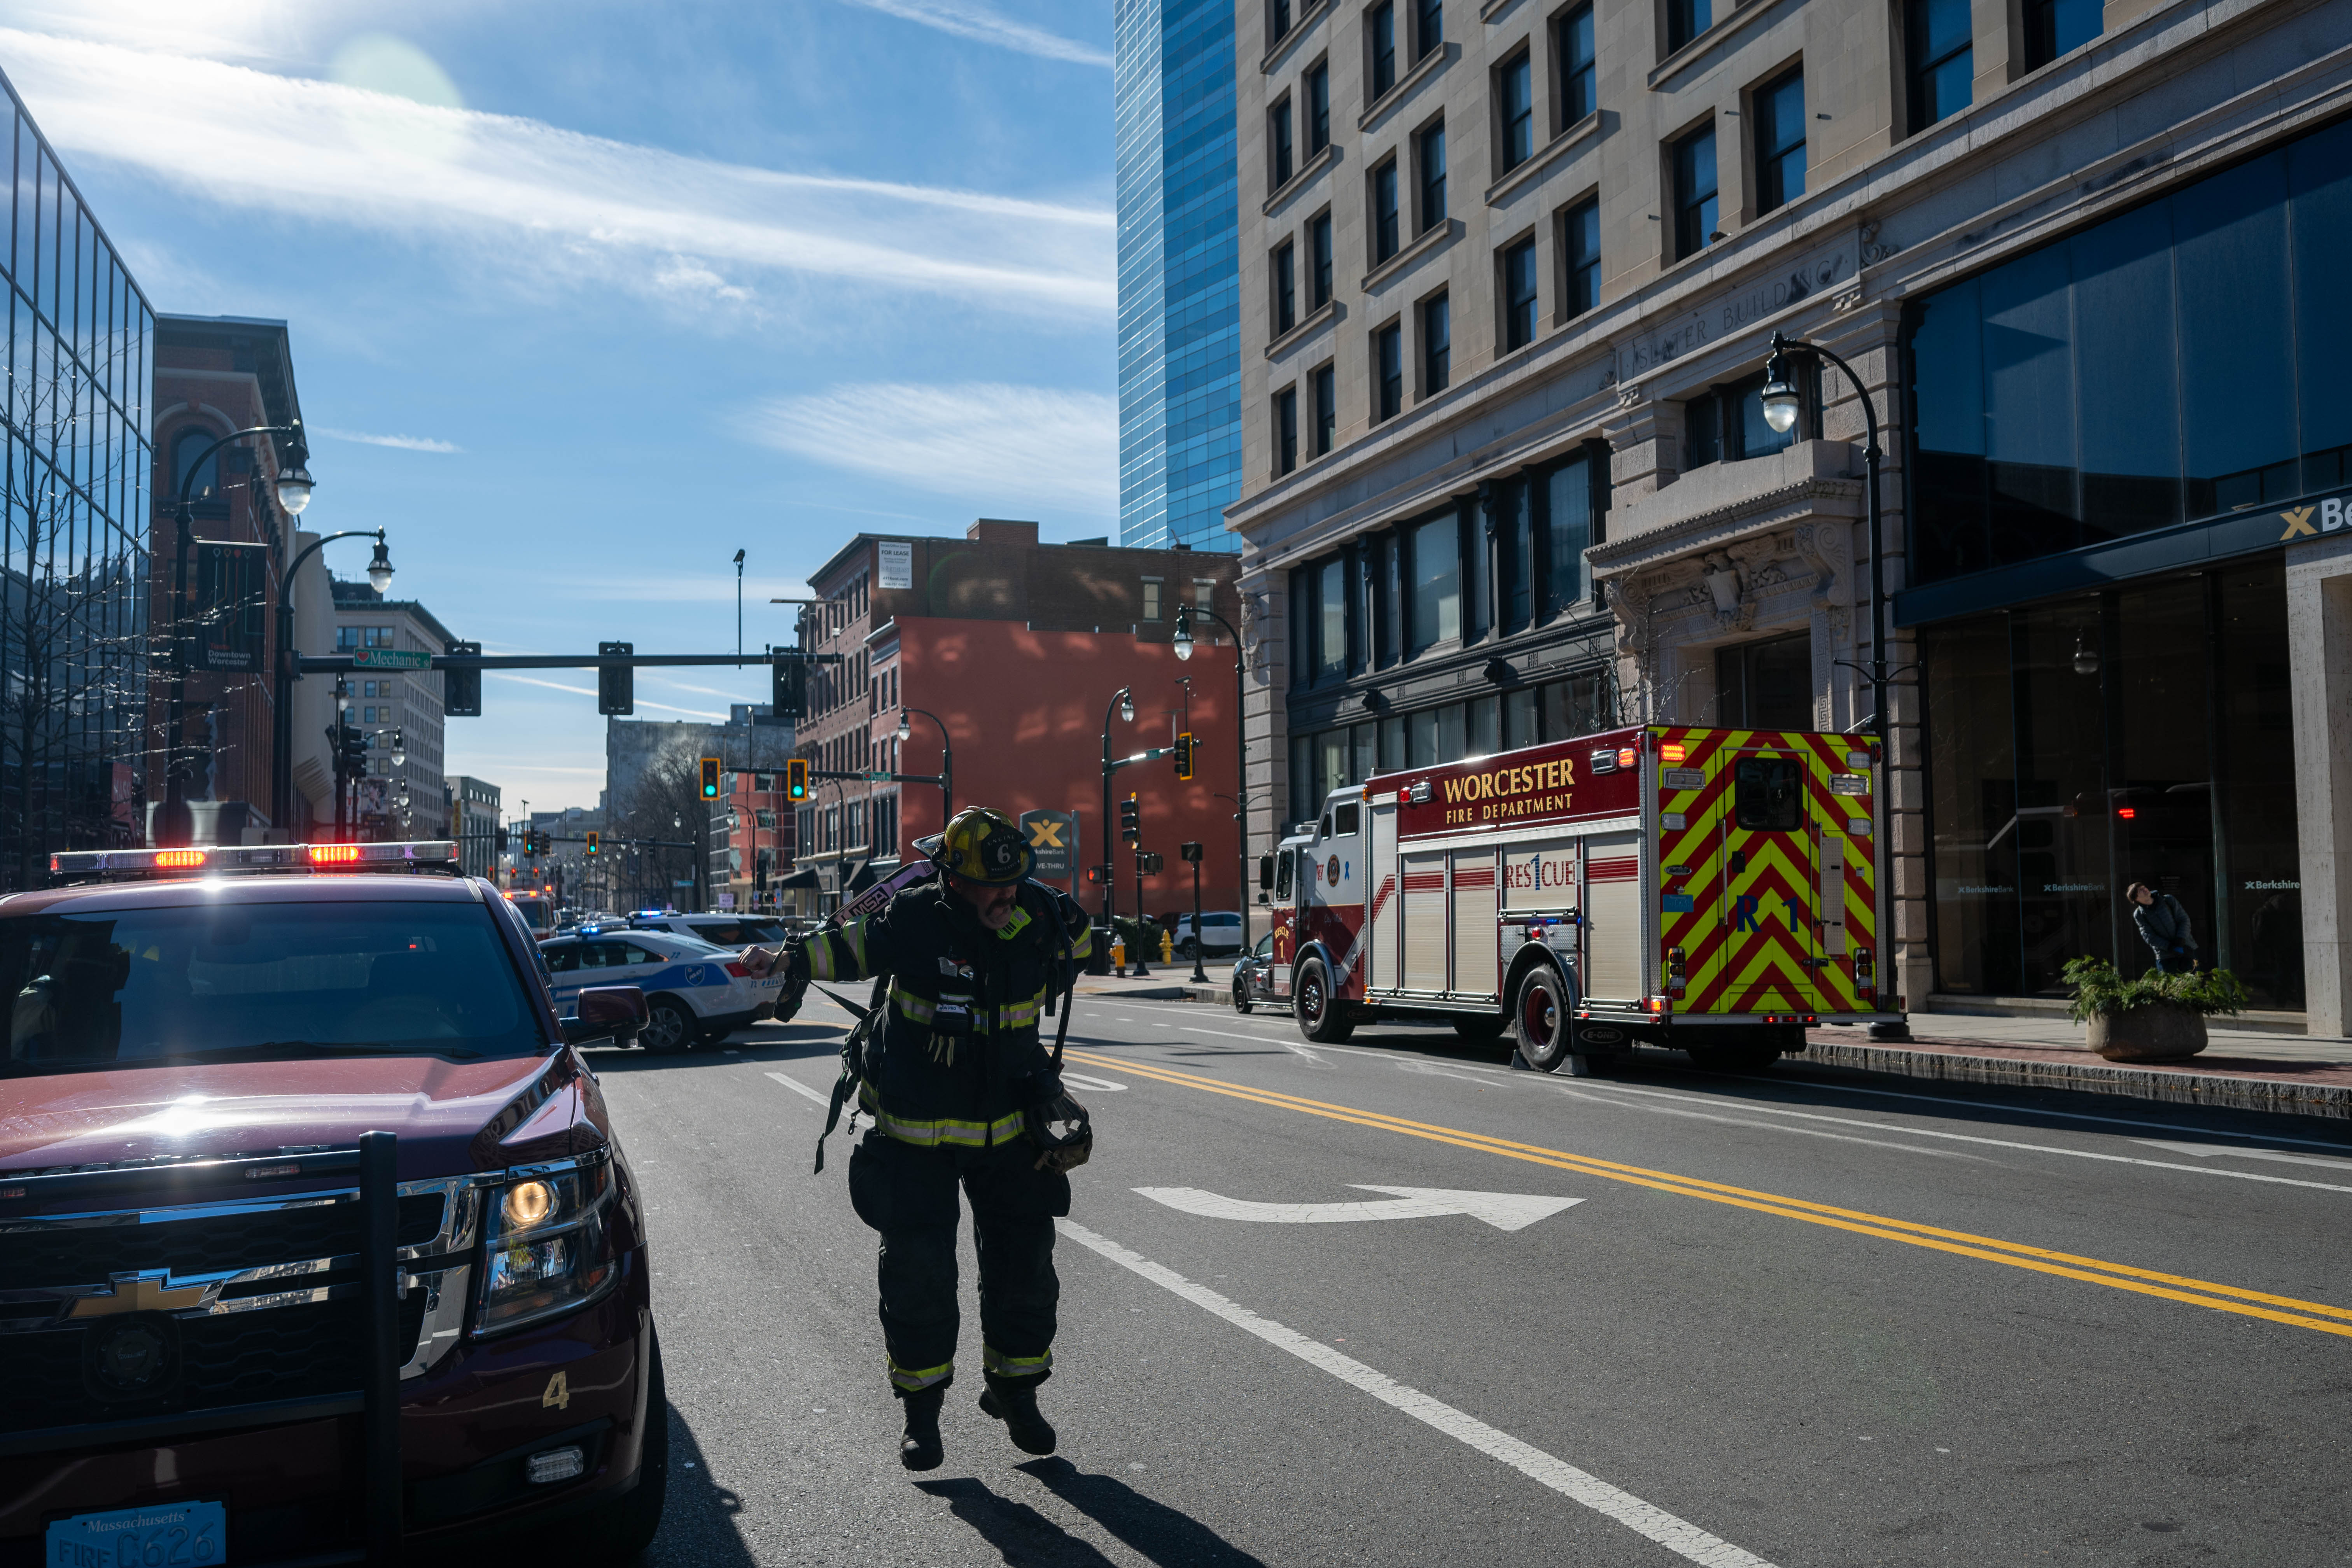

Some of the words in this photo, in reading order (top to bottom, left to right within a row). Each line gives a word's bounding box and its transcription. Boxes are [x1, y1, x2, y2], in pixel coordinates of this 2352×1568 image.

[1638, 319, 1708, 369] SLATER
[1723, 259, 1832, 330] BUILDING
[208, 650, 251, 658] Downtown
[208, 657, 248, 666] Worcester
[370, 651, 420, 667] Mechanic
[1444, 758, 1576, 804] WORCESTER
[1446, 809, 1473, 824] FIRE
[1482, 793, 1573, 819] DEPARTMENT
[987, 833, 1015, 846] ENGINE
[997, 843, 1011, 864] 6
[2052, 883, 2105, 891] BerkshireBank
[852, 891, 888, 916] MSA
[1736, 895, 1760, 933] R
[1781, 896, 1798, 932] 1
[1274, 926, 1290, 940] RESCUE
[1279, 940, 1284, 959] 1
[1587, 1031, 1616, 1039] E-ONE
[542, 1371, 569, 1410] 4
[88, 1512, 185, 1533] Massachusetts
[60, 1538, 112, 1568] FIRE
[117, 1521, 214, 1568] C626
